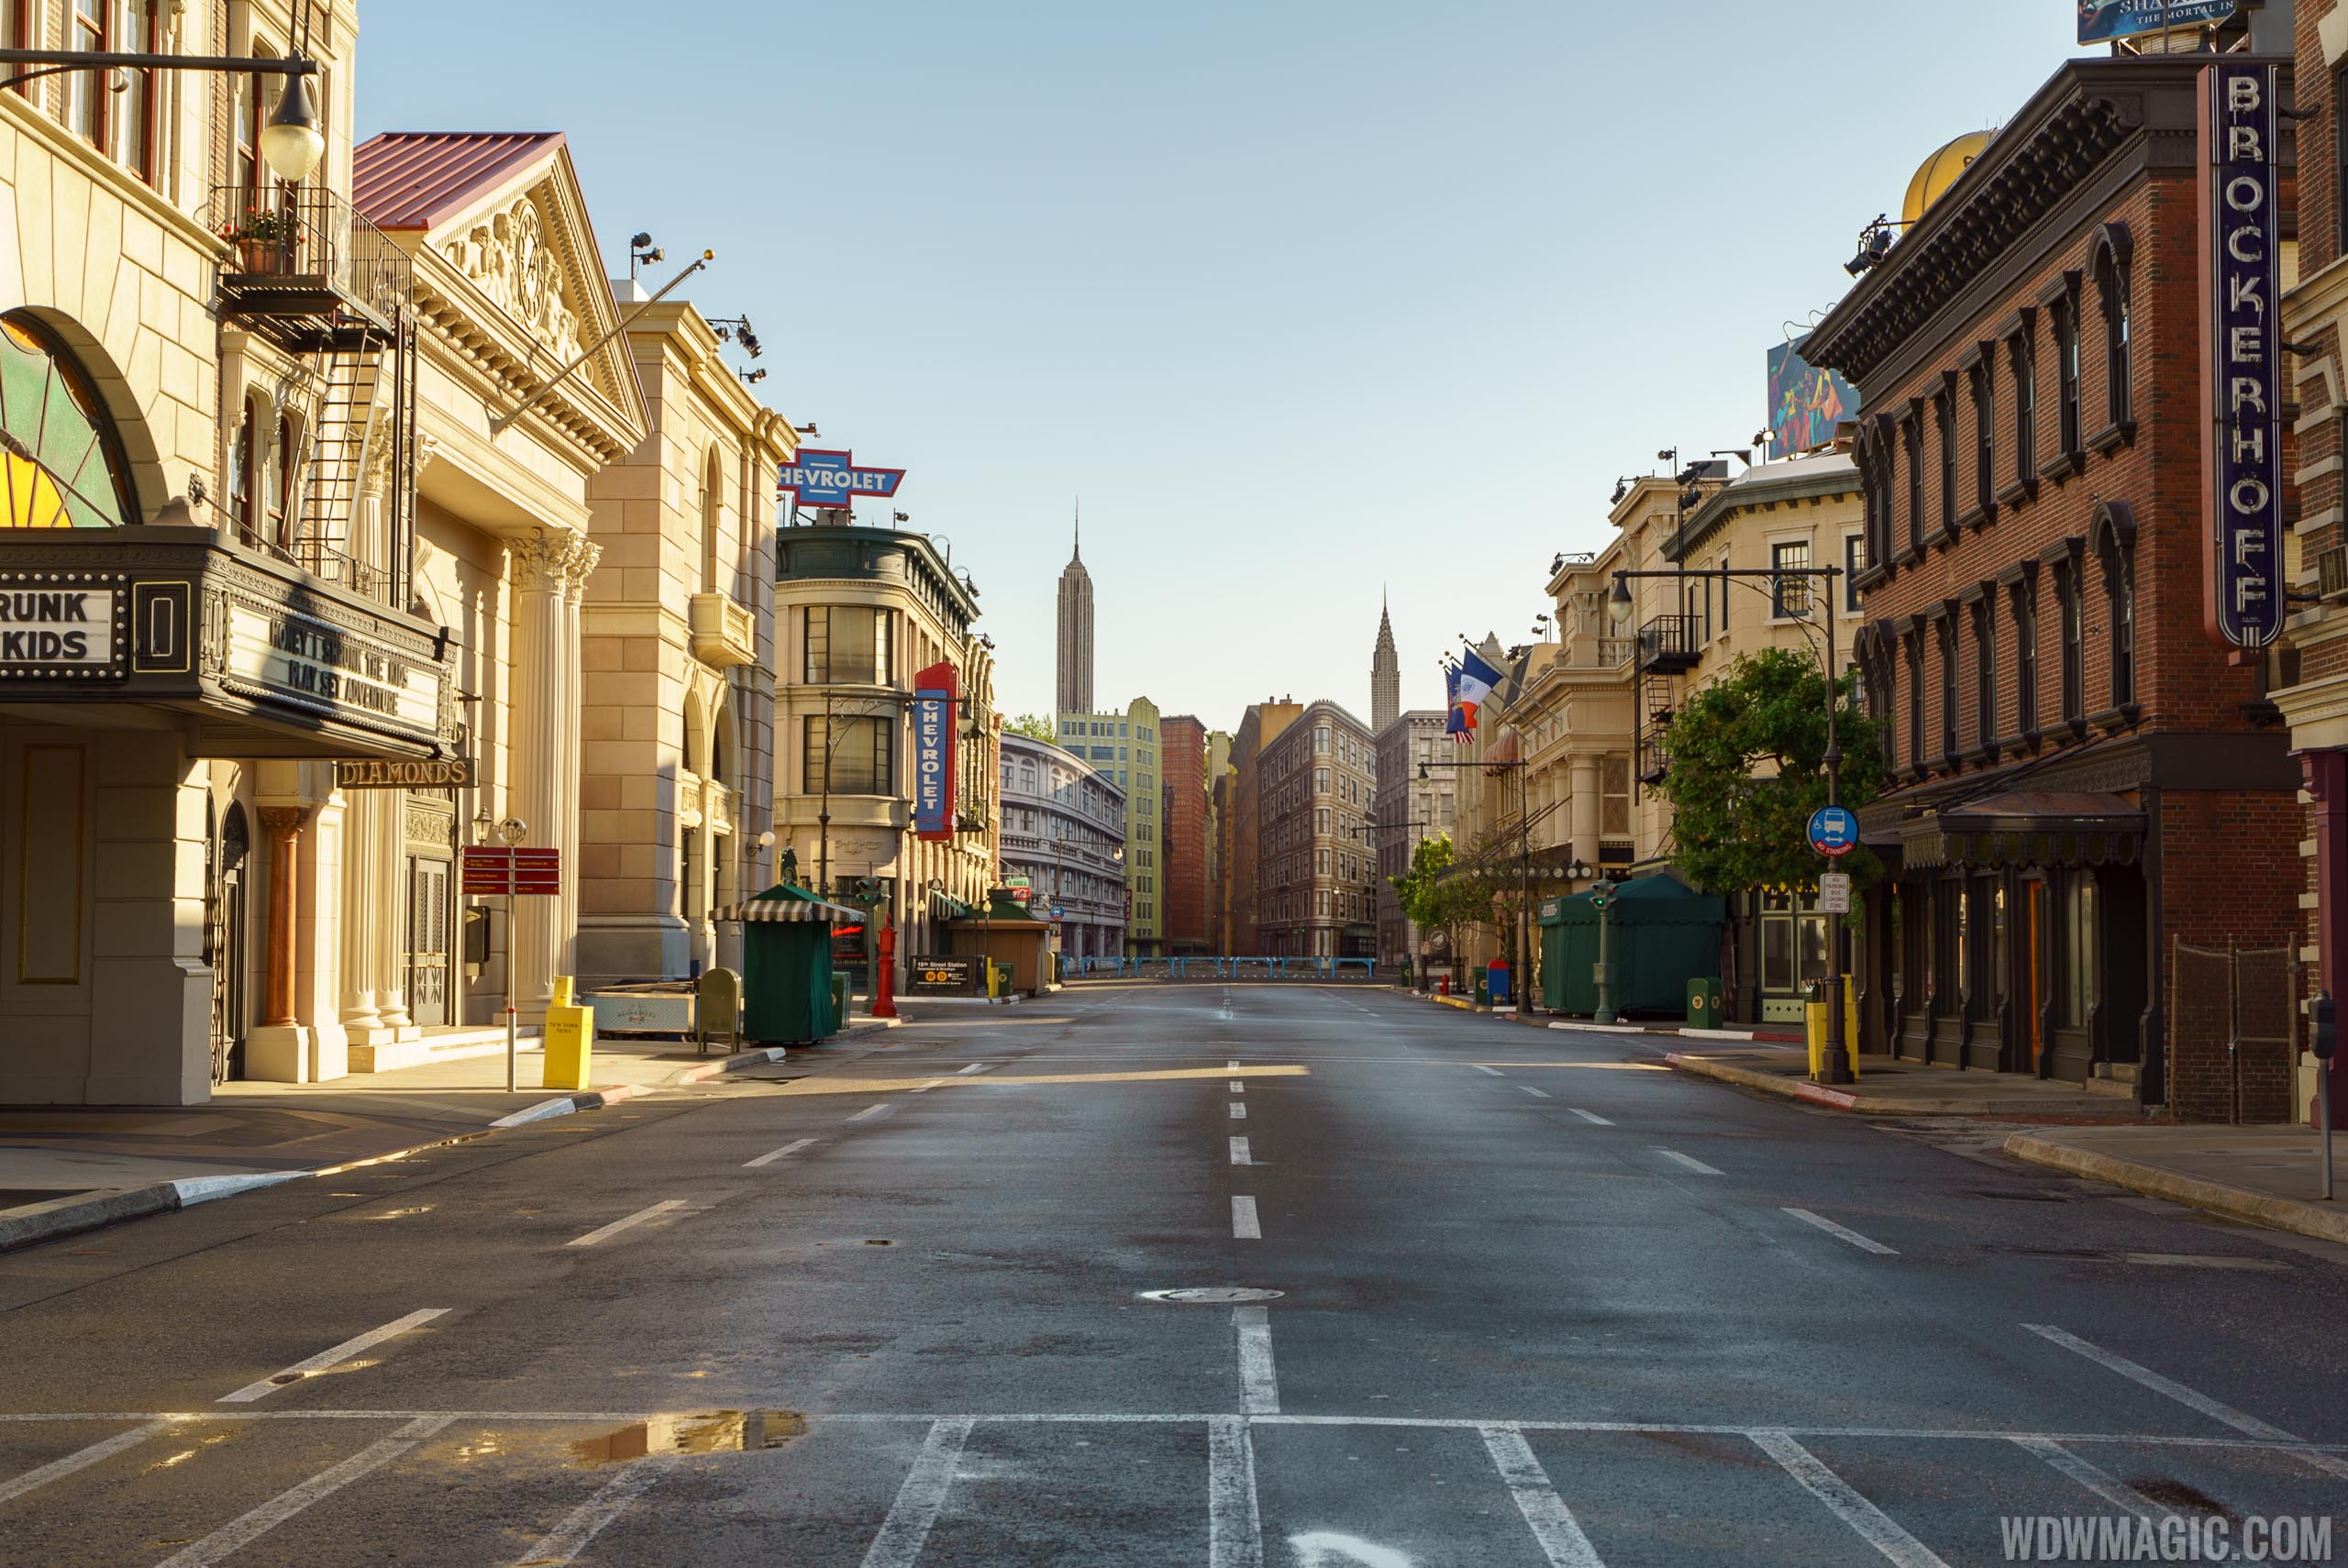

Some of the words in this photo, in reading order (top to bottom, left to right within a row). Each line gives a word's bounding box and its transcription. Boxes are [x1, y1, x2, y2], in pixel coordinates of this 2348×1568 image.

[2136, 14, 2160, 25] THE
[2167, 4, 2215, 19] MORTAL
[2226, 76, 2268, 613] BROCKERHOFF
[778, 468, 886, 491] HEVROLET
[2, 630, 87, 660] KIDS
[270, 618, 307, 657] HONEY
[313, 634, 317, 660] I
[322, 637, 363, 675] SHRUNK
[365, 651, 384, 682] THE
[387, 659, 408, 689] KIDS
[289, 659, 317, 692] PLAY
[321, 670, 341, 700] SET
[345, 677, 399, 716] ADVENTURE
[922, 701, 939, 810] CHEVROLET
[342, 760, 468, 785] DIAMONDS
[1816, 841, 1825, 850] NO
[1825, 843, 1852, 855] STANDING
